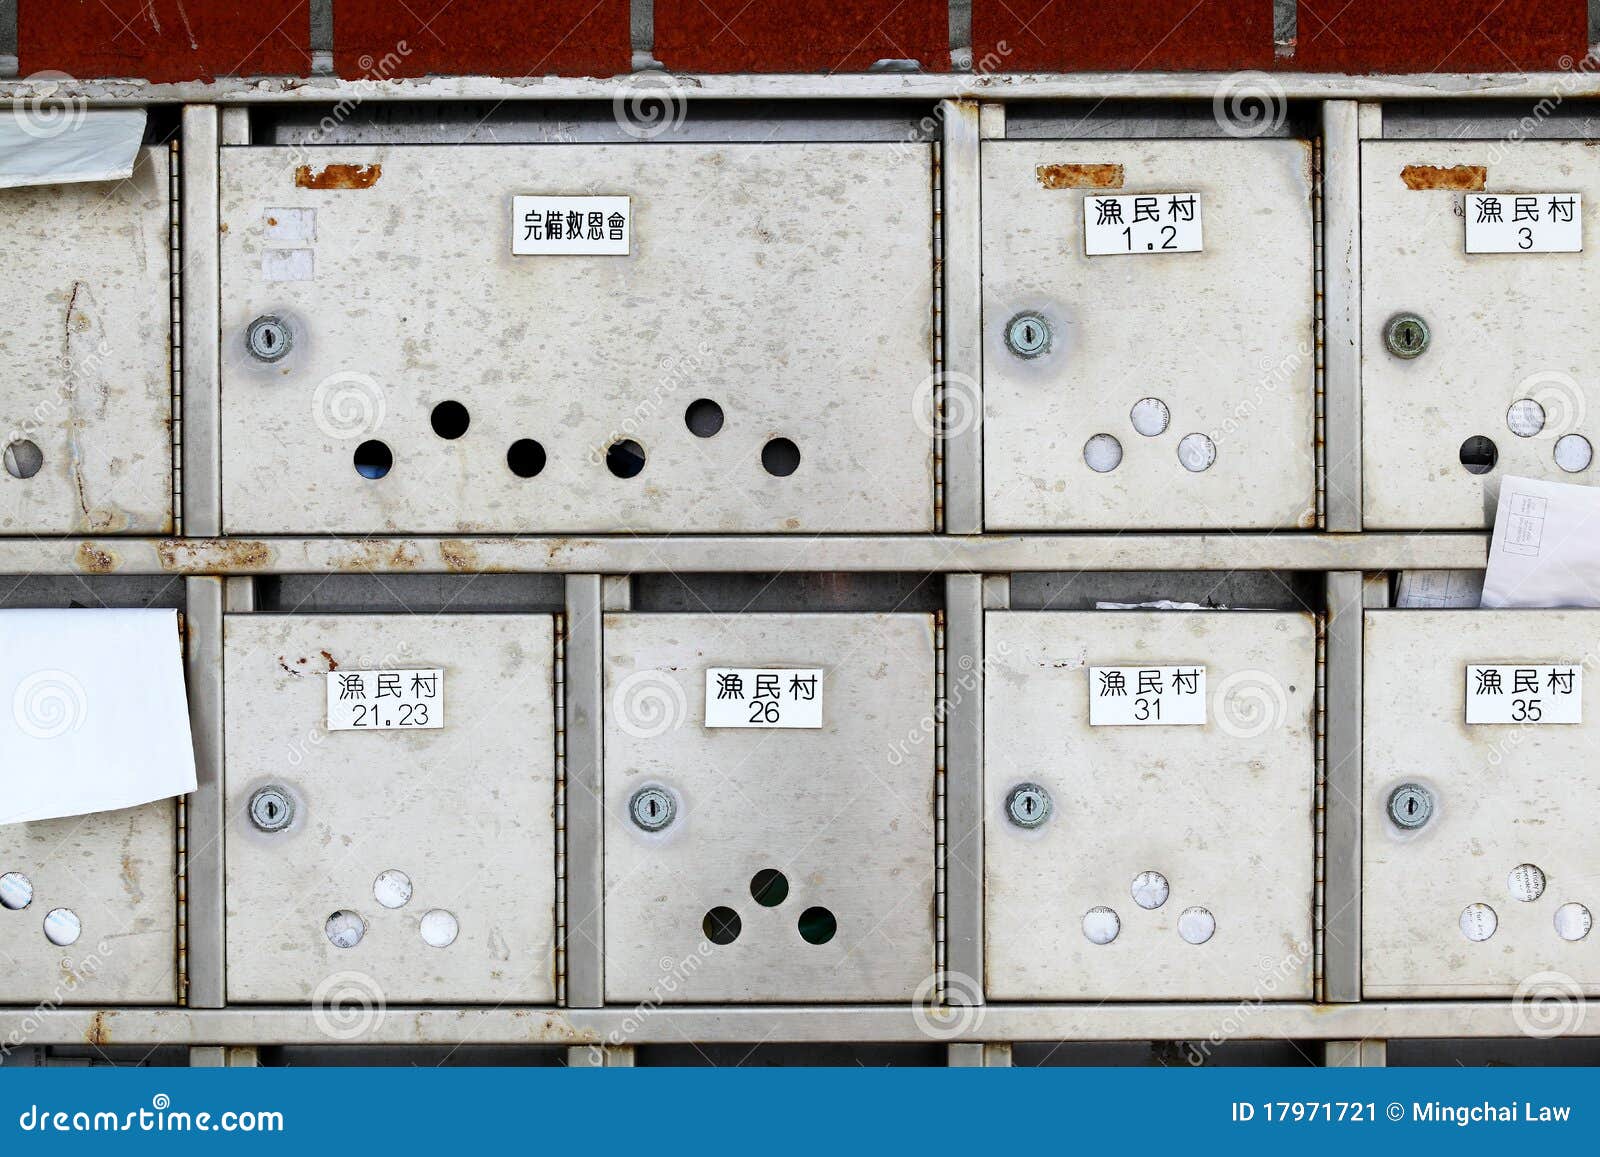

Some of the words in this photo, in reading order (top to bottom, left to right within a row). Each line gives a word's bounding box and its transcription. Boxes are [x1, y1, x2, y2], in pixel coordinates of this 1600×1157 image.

[1095, 195, 1196, 225] 漁民村
[1476, 196, 1576, 223] 漁民村
[524, 210, 625, 240] 完備救恩會
[1518, 227, 1533, 250] 3
[338, 673, 438, 700] 漁民村
[717, 673, 818, 700] 漁民村
[1099, 669, 1200, 696] 漁民村
[1476, 668, 1575, 695] 漁民村
[352, 704, 429, 726] 21.23
[748, 701, 780, 723] 26
[1134, 698, 1160, 720] 31
[1511, 699, 1542, 721] 35
